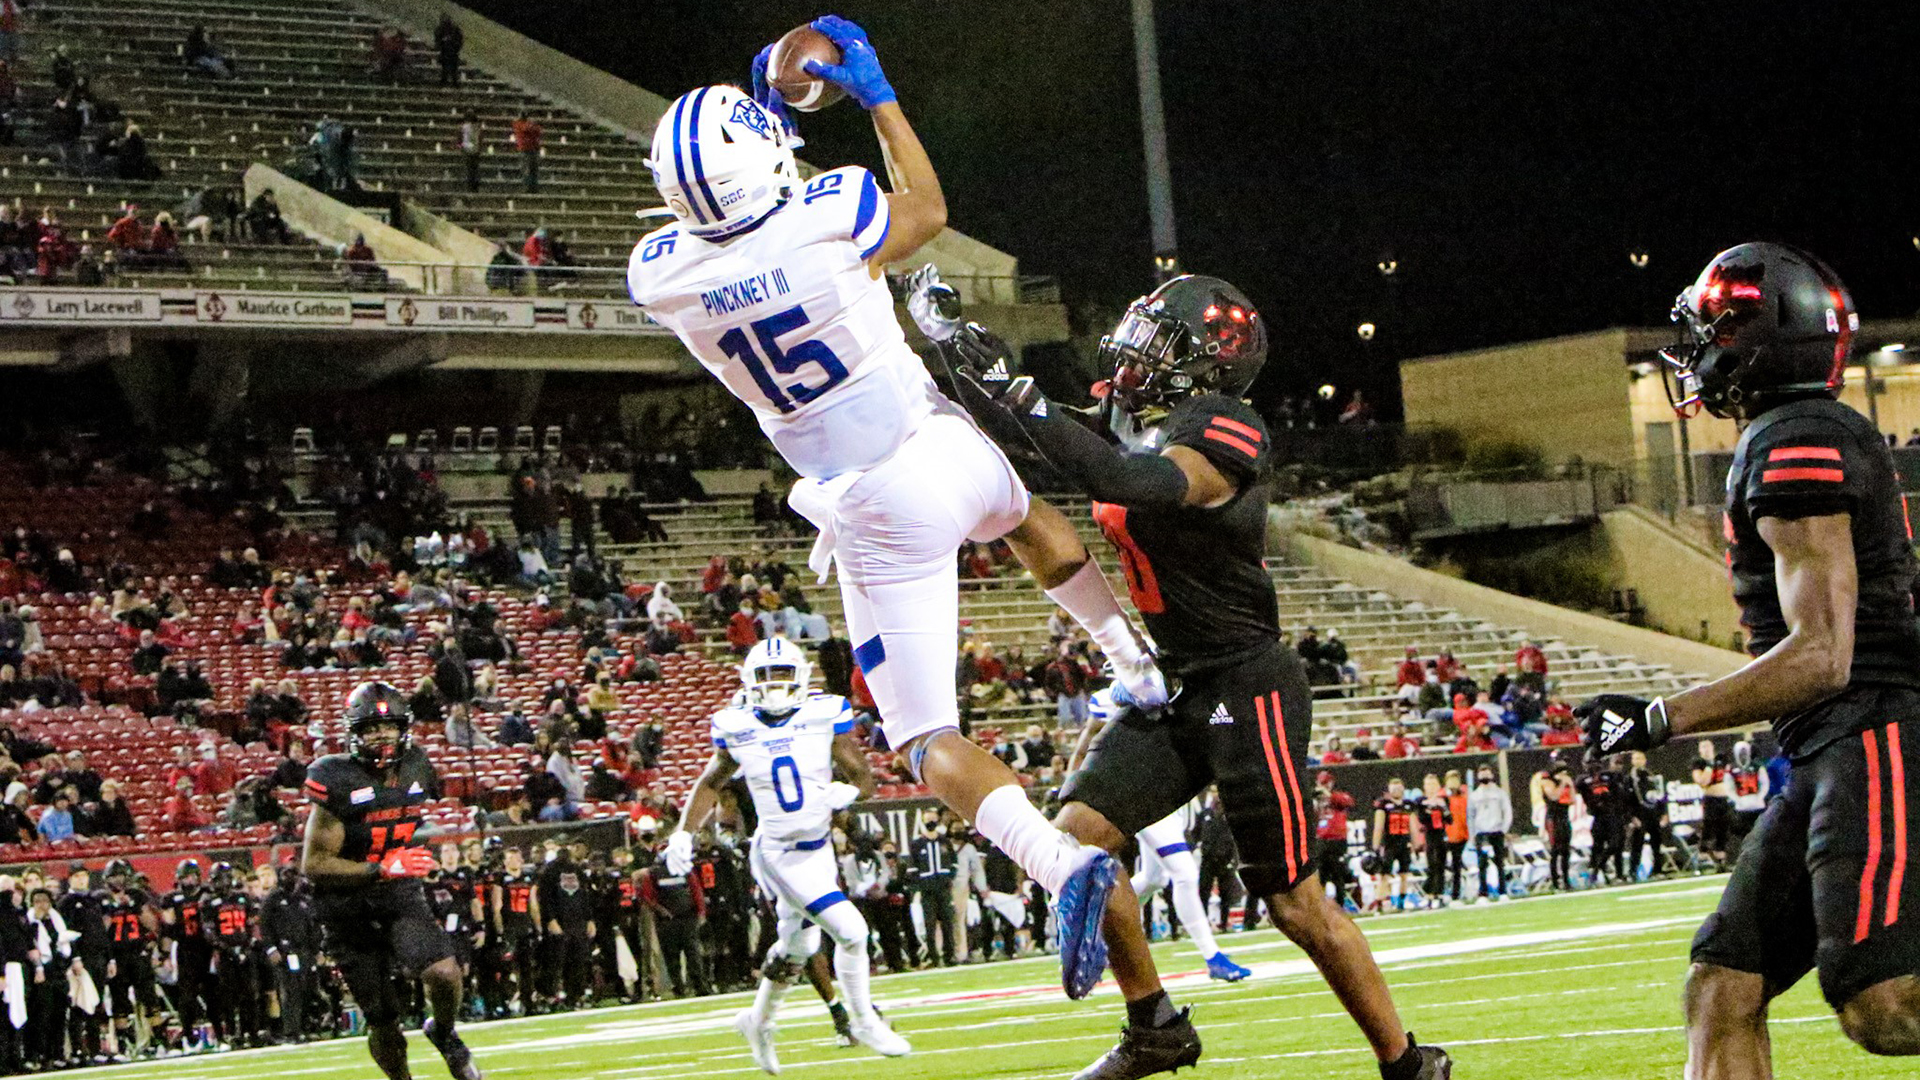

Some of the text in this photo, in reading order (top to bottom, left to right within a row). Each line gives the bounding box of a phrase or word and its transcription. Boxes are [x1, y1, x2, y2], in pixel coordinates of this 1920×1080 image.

[804, 174, 843, 205] 15
[641, 230, 678, 263] 15
[701, 273, 770, 317] PINCKNEY
[771, 268, 790, 296] III
[47, 299, 142, 319] Larry Lacewell
[237, 299, 289, 316] Maurice
[438, 306, 508, 326] Bill Phillips
[615, 310, 637, 324] Tim
[717, 304, 850, 414] 15
[1209, 716, 1234, 725] adidas
[1601, 718, 1635, 751] adidas
[771, 756, 804, 813] 0
[111, 914, 140, 942] 73
[219, 910, 246, 935] 24
